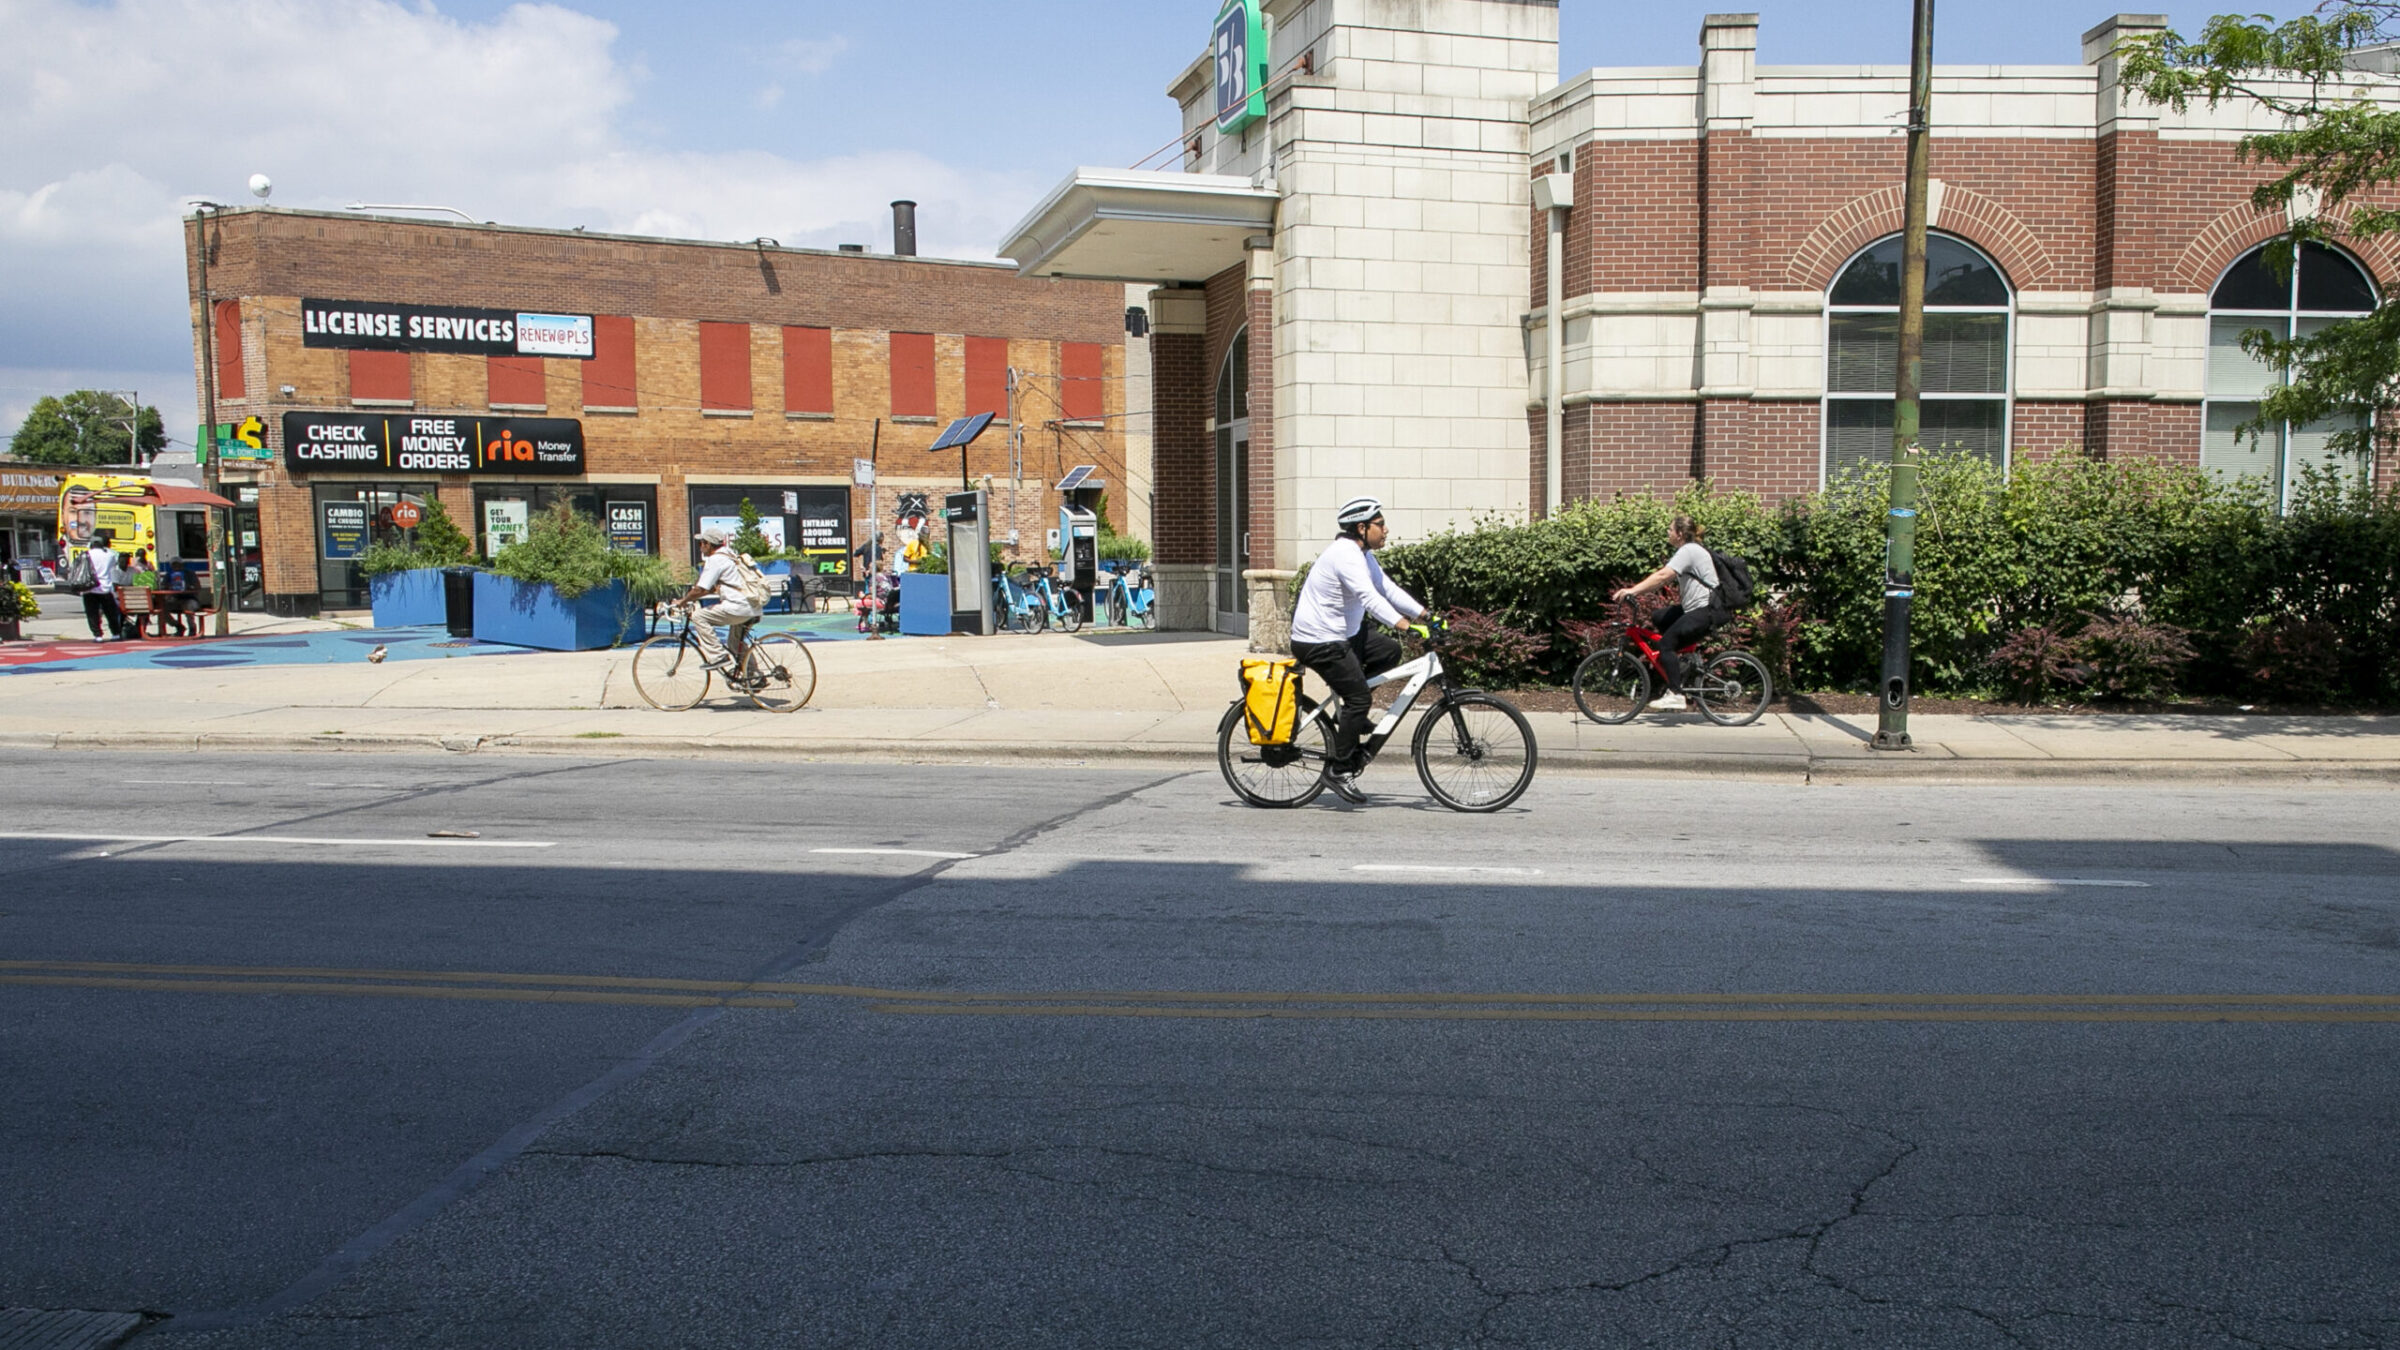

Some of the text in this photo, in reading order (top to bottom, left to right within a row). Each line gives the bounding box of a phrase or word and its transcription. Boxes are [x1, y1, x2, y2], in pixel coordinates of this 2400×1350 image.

[305, 310, 514, 342] LICENSE SERVICES
[520, 327, 590, 344] RENEW@PLS
[307, 425, 366, 441] CHECK
[411, 419, 456, 435] FREE
[402, 436, 466, 452] MONEY
[488, 430, 534, 461] ria
[538, 441, 572, 453] Money
[298, 444, 378, 460] CASHING
[538, 452, 577, 462] Transfer
[399, 453, 471, 469] ORDERS
[2, 474, 58, 487] BUILDERS
[328, 508, 363, 517] CAMBIO
[397, 505, 417, 518] ria
[611, 509, 642, 521] CASH
[491, 524, 523, 532] MONEY
[611, 522, 643, 530] CHECKS
[802, 519, 838, 528] ENTRANCE
[803, 528, 833, 536] AROUND
[803, 537, 846, 545] THE CORNER
